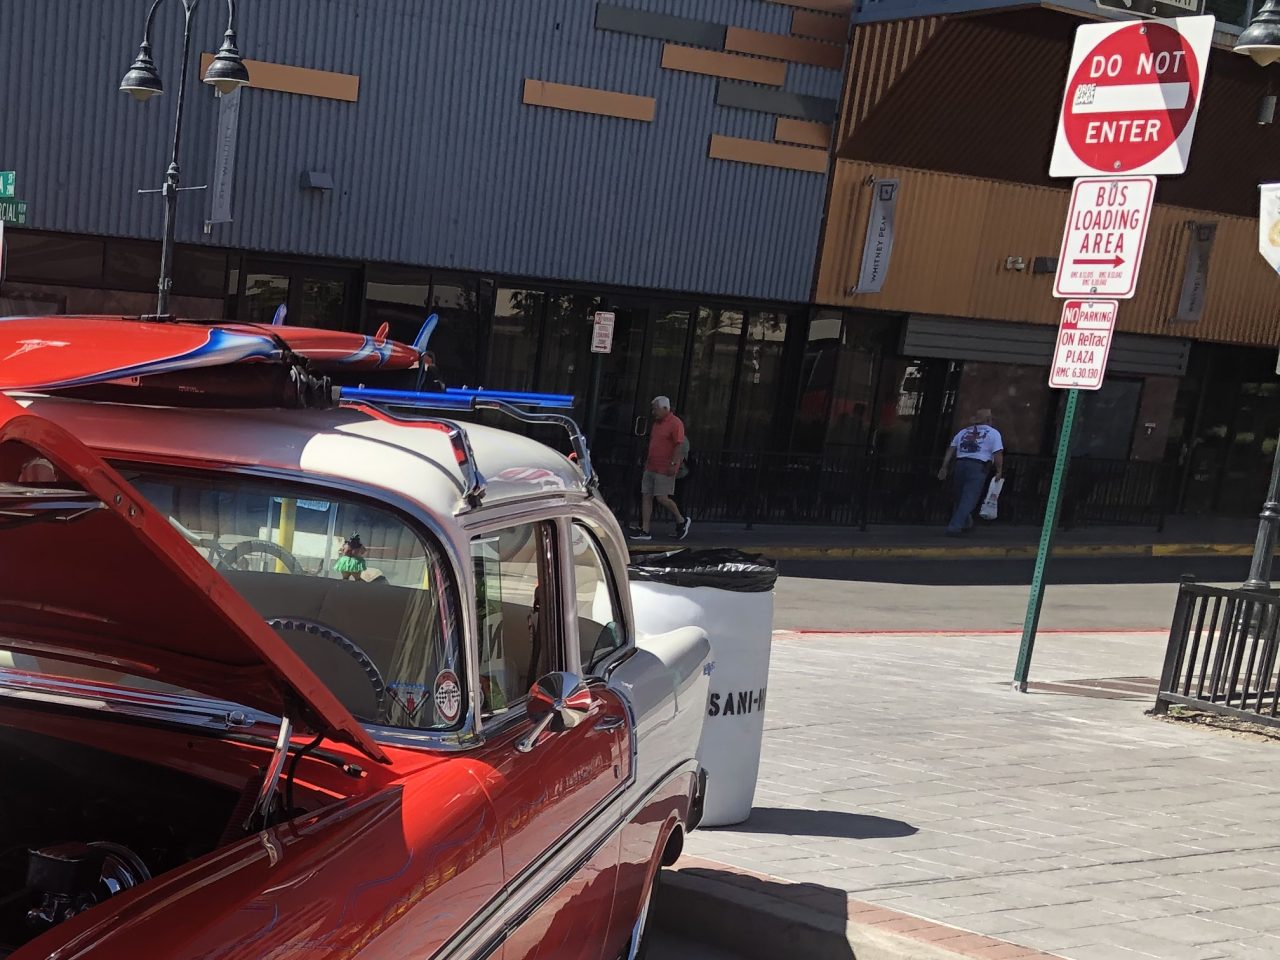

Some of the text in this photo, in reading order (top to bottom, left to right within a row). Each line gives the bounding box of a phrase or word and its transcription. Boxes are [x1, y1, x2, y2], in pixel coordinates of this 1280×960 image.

[1090, 50, 1185, 78] DO NOT
[1085, 119, 1161, 144] ENTER
[1095, 186, 1128, 207] BUS
[1074, 208, 1140, 231] LOADING
[1079, 233, 1124, 254] AREA
[870, 240, 884, 283] WHITNEY
[1063, 307, 1079, 324] NO
[1080, 311, 1112, 323] PARKING
[1061, 332, 1107, 347] ON ReTrac
[1065, 349, 1094, 364] PLAZA
[1055, 367, 1070, 378] RMC
